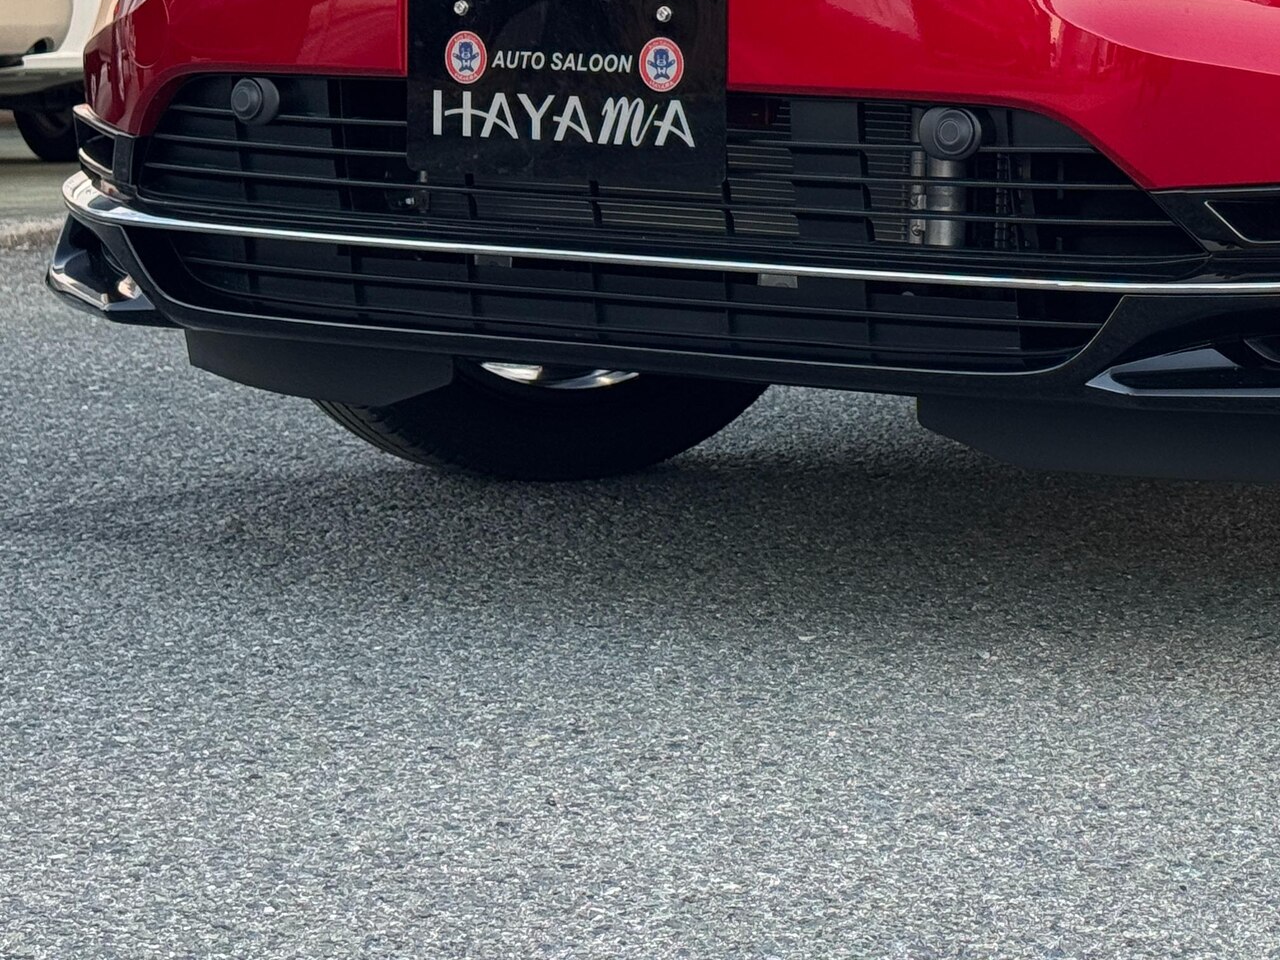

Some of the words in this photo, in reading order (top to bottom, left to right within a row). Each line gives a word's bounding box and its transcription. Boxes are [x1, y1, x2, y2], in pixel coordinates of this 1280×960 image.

[491, 50, 546, 70] AUTO
[550, 51, 634, 74] SALOON
[432, 89, 696, 148] HAYAMA
